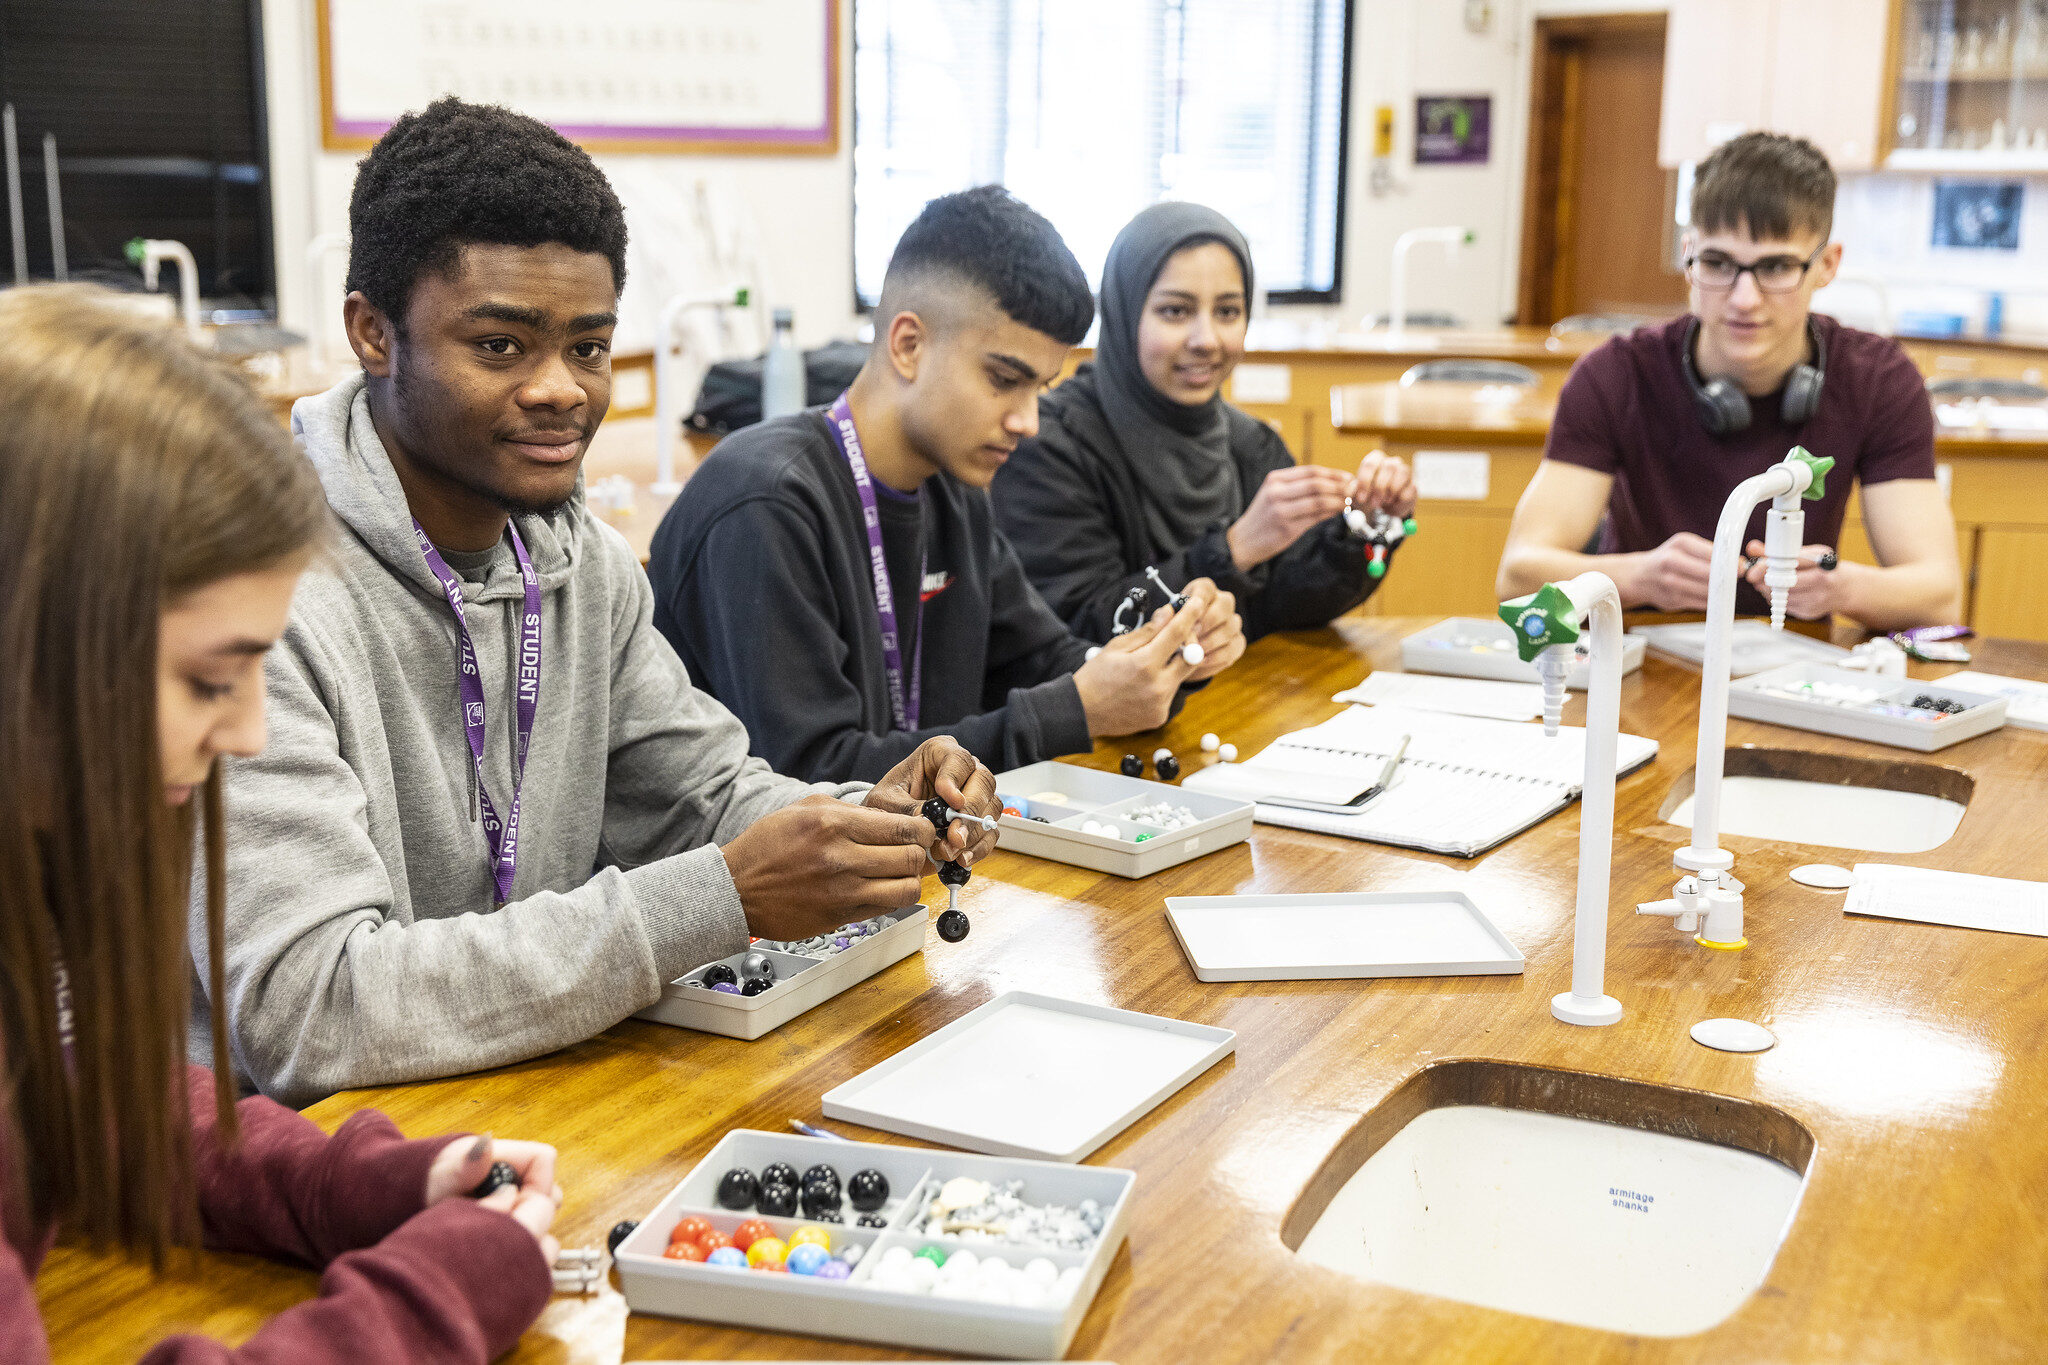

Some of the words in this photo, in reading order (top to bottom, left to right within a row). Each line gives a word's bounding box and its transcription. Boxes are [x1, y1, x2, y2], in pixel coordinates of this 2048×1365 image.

[838, 418, 871, 487] STUDENT
[871, 545, 893, 614] STUDENT
[519, 613, 540, 704] STUDENT
[1609, 1188, 1654, 1203] armitage
[1613, 1199, 1648, 1213] shanks
